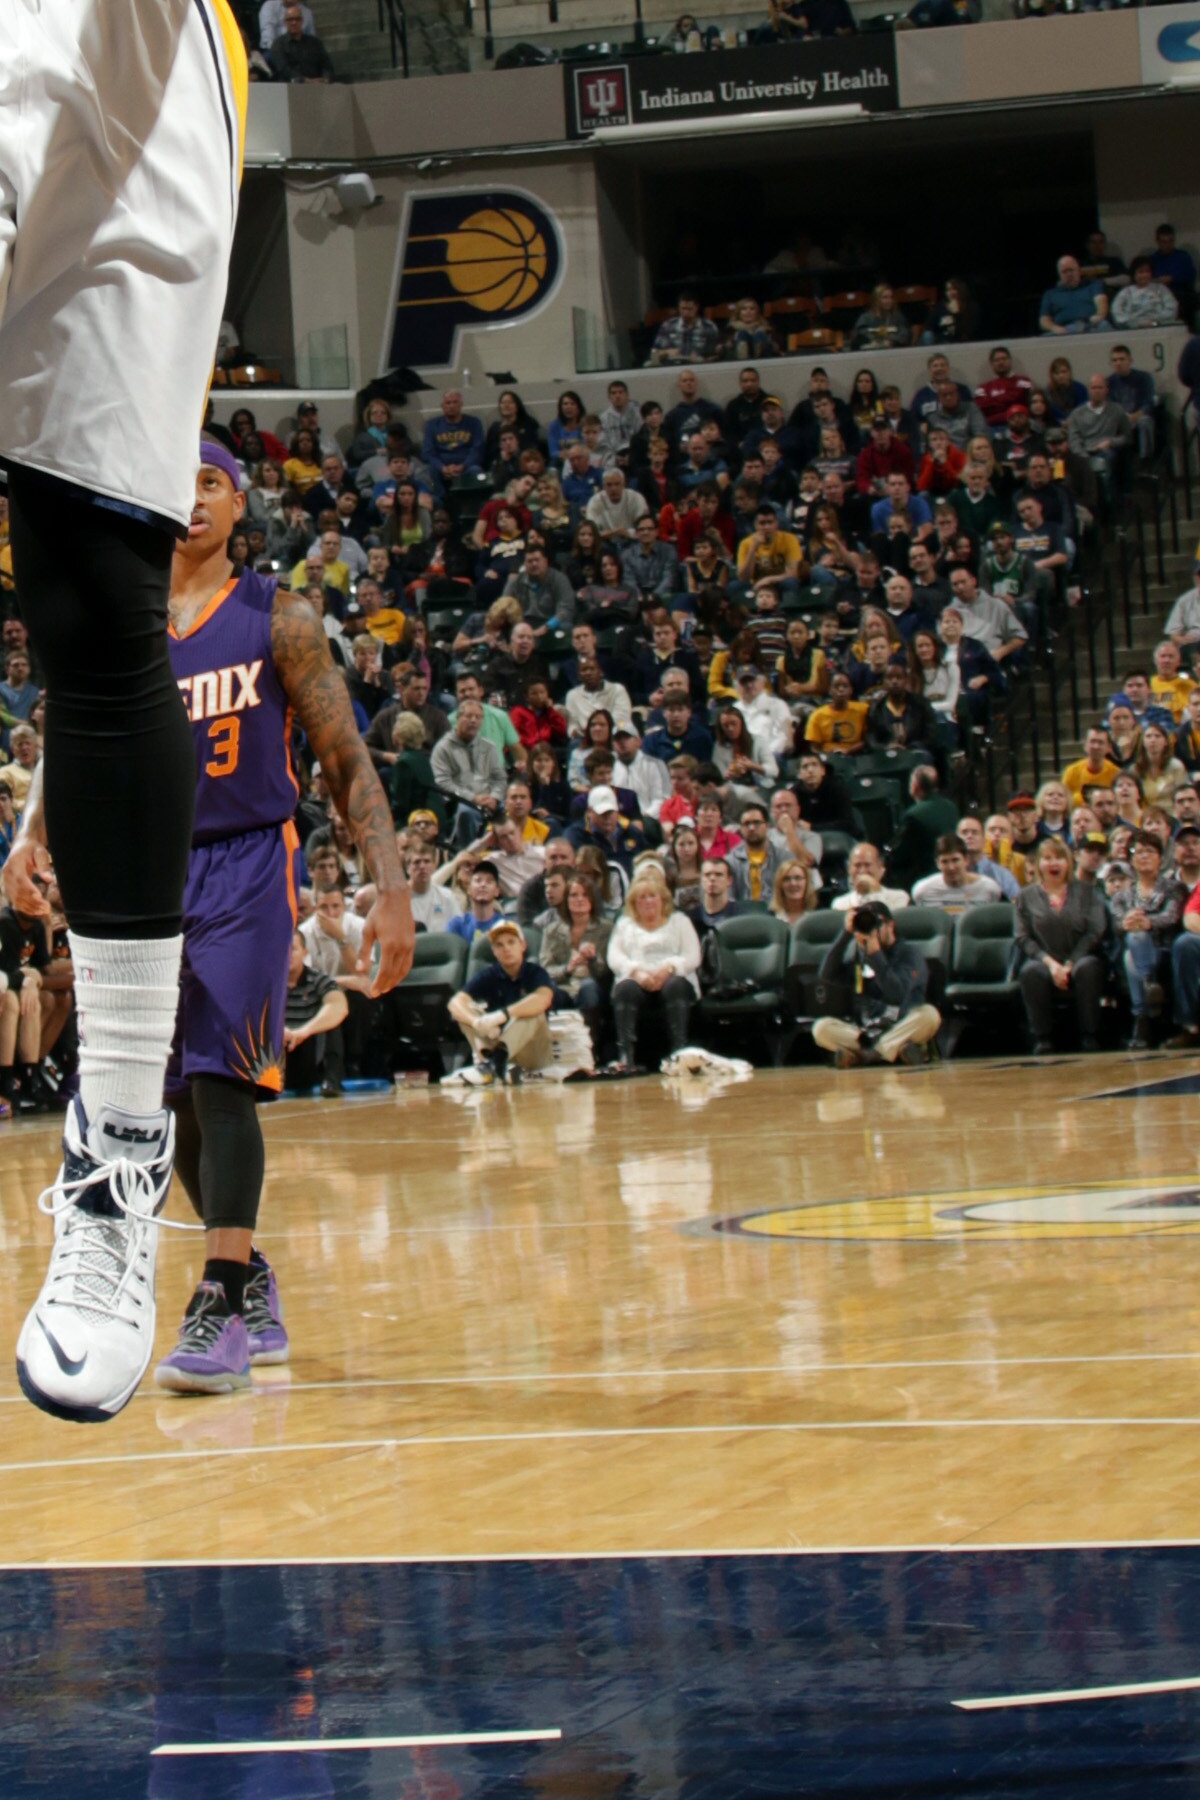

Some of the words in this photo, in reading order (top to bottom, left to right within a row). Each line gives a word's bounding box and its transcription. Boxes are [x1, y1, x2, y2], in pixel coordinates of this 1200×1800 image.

[639, 86, 715, 110] Indiana
[719, 75, 818, 102] University
[822, 67, 890, 93] Health
[1153, 342, 1165, 373] 9
[205, 715, 240, 777] 3
